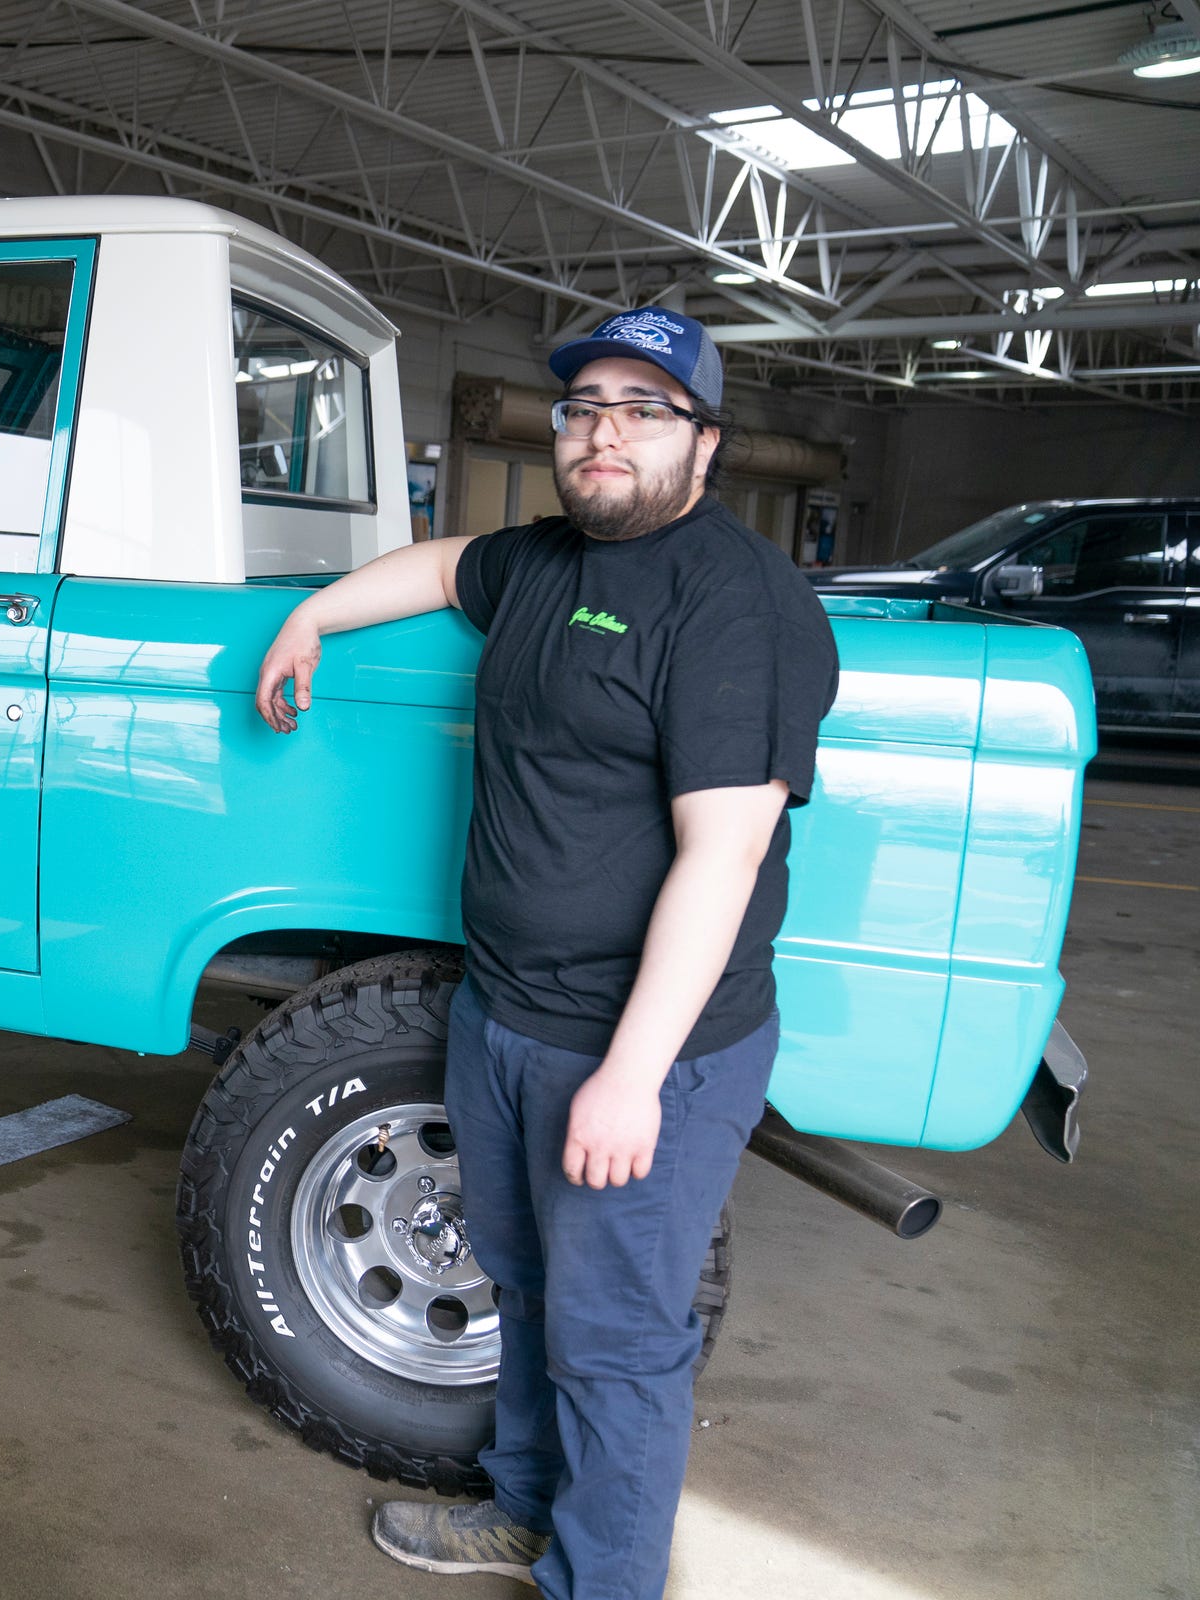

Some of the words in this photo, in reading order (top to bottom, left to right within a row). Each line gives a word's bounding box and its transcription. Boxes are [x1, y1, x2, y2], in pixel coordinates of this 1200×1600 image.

[613, 325, 659, 341] Ford
[244, 1126, 297, 1338] All-Terrain
[305, 1077, 368, 1117] T/A
